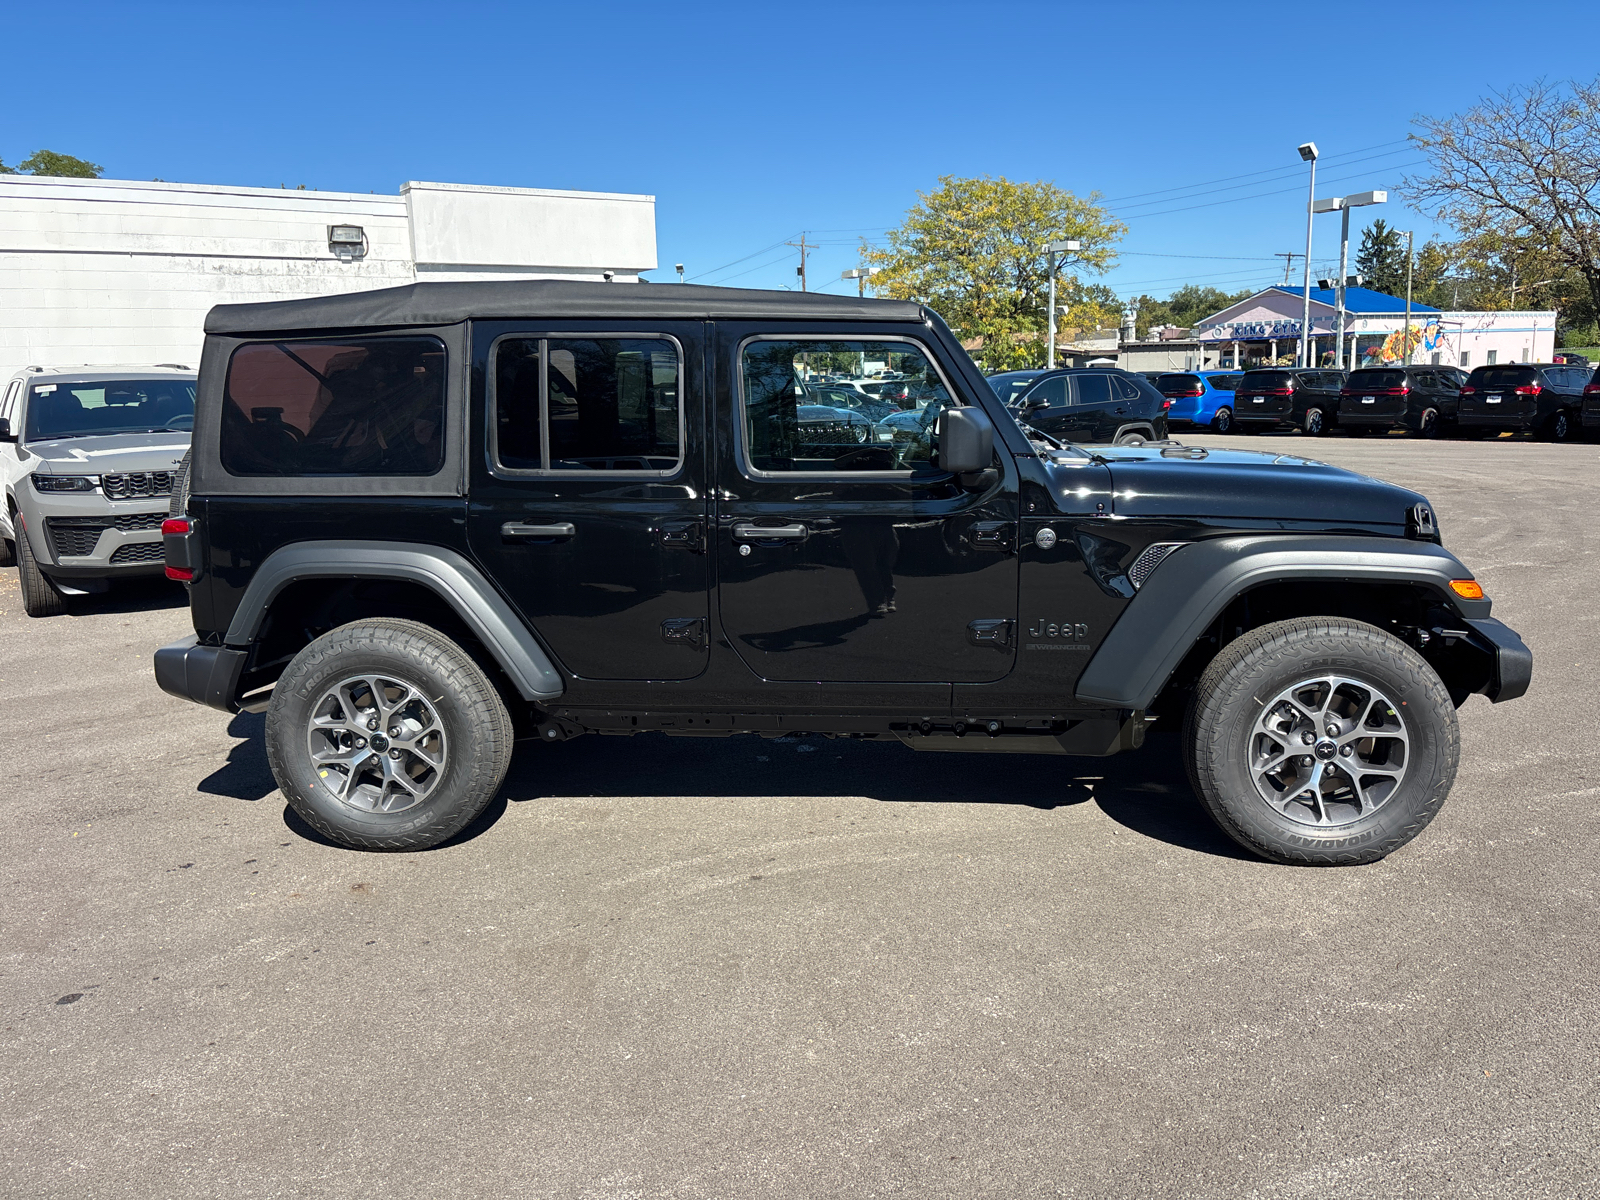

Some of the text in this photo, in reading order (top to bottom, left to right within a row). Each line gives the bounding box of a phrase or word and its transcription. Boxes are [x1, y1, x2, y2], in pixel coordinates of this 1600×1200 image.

[1234, 325, 1265, 336] KING
[1029, 618, 1089, 642] Jeep
[1287, 832, 1372, 849] ROADIAN
